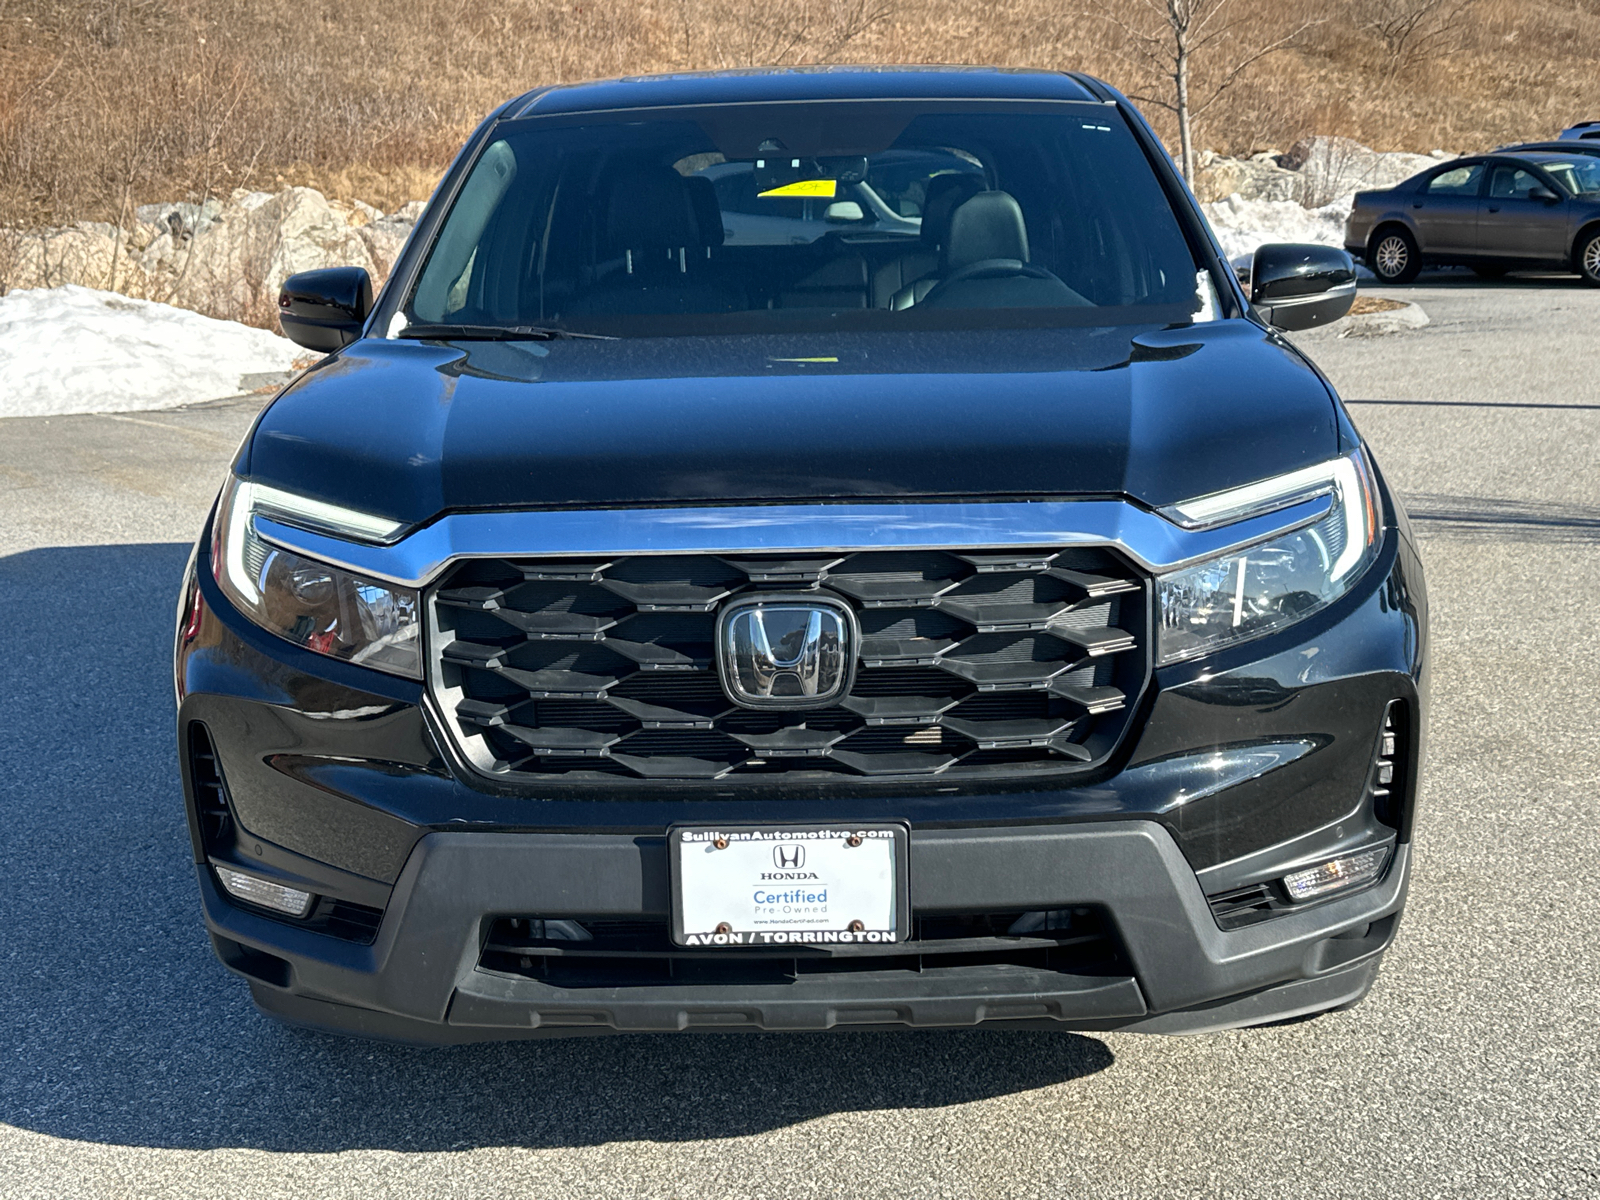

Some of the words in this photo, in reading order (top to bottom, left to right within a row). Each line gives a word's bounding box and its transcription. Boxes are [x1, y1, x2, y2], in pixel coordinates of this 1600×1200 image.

[682, 830, 894, 842] SullivanAutomotive.com
[760, 872, 819, 880] HONDA
[753, 889, 828, 904] Certified
[754, 904, 828, 914] Pre-Owned
[685, 932, 743, 946] AVON
[748, 933, 756, 944] /
[760, 931, 897, 944] TORRINGTON
